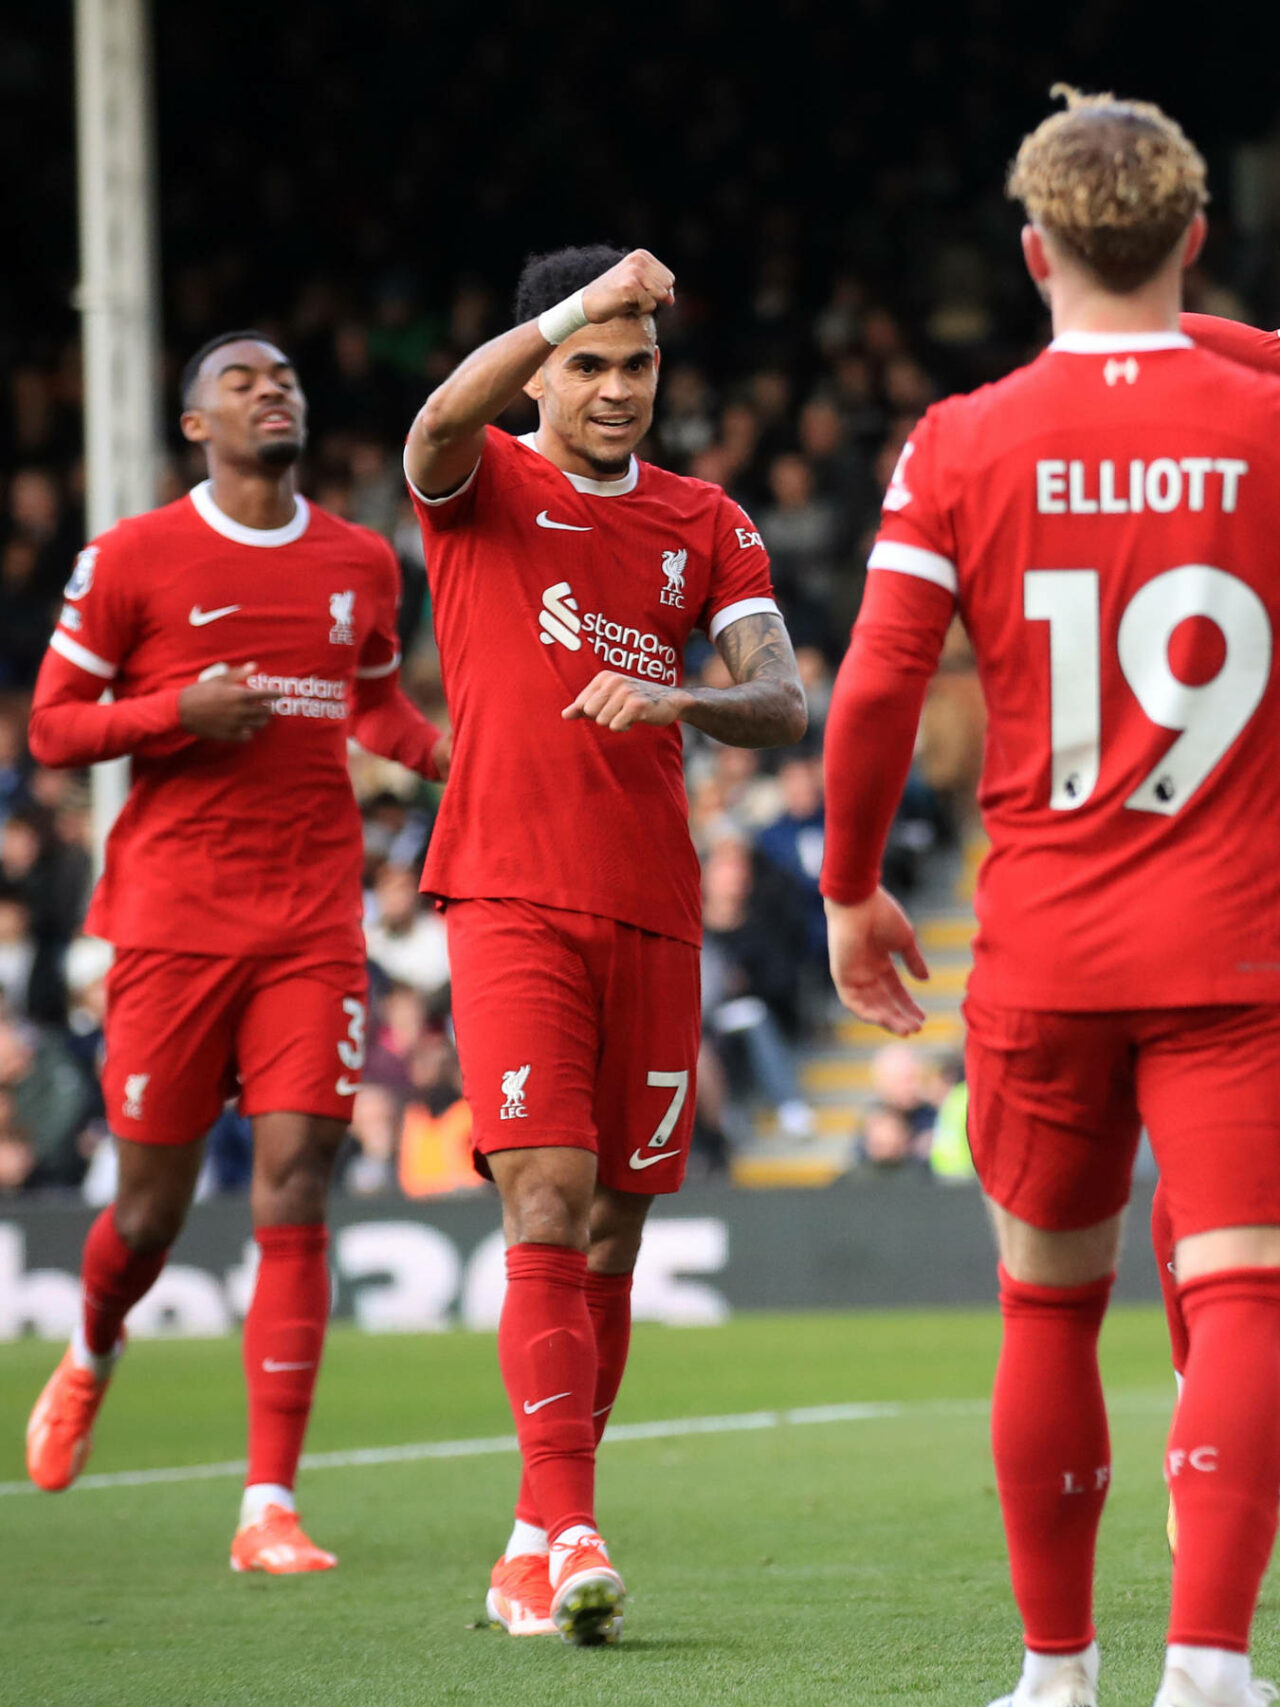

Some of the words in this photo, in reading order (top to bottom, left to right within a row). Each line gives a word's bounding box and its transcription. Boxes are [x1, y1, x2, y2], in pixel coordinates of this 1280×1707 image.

[1036, 457, 1248, 514] ELLIOTT
[1024, 564, 1272, 816] 19
[337, 998, 365, 1070] 3
[647, 1070, 688, 1147] 7
